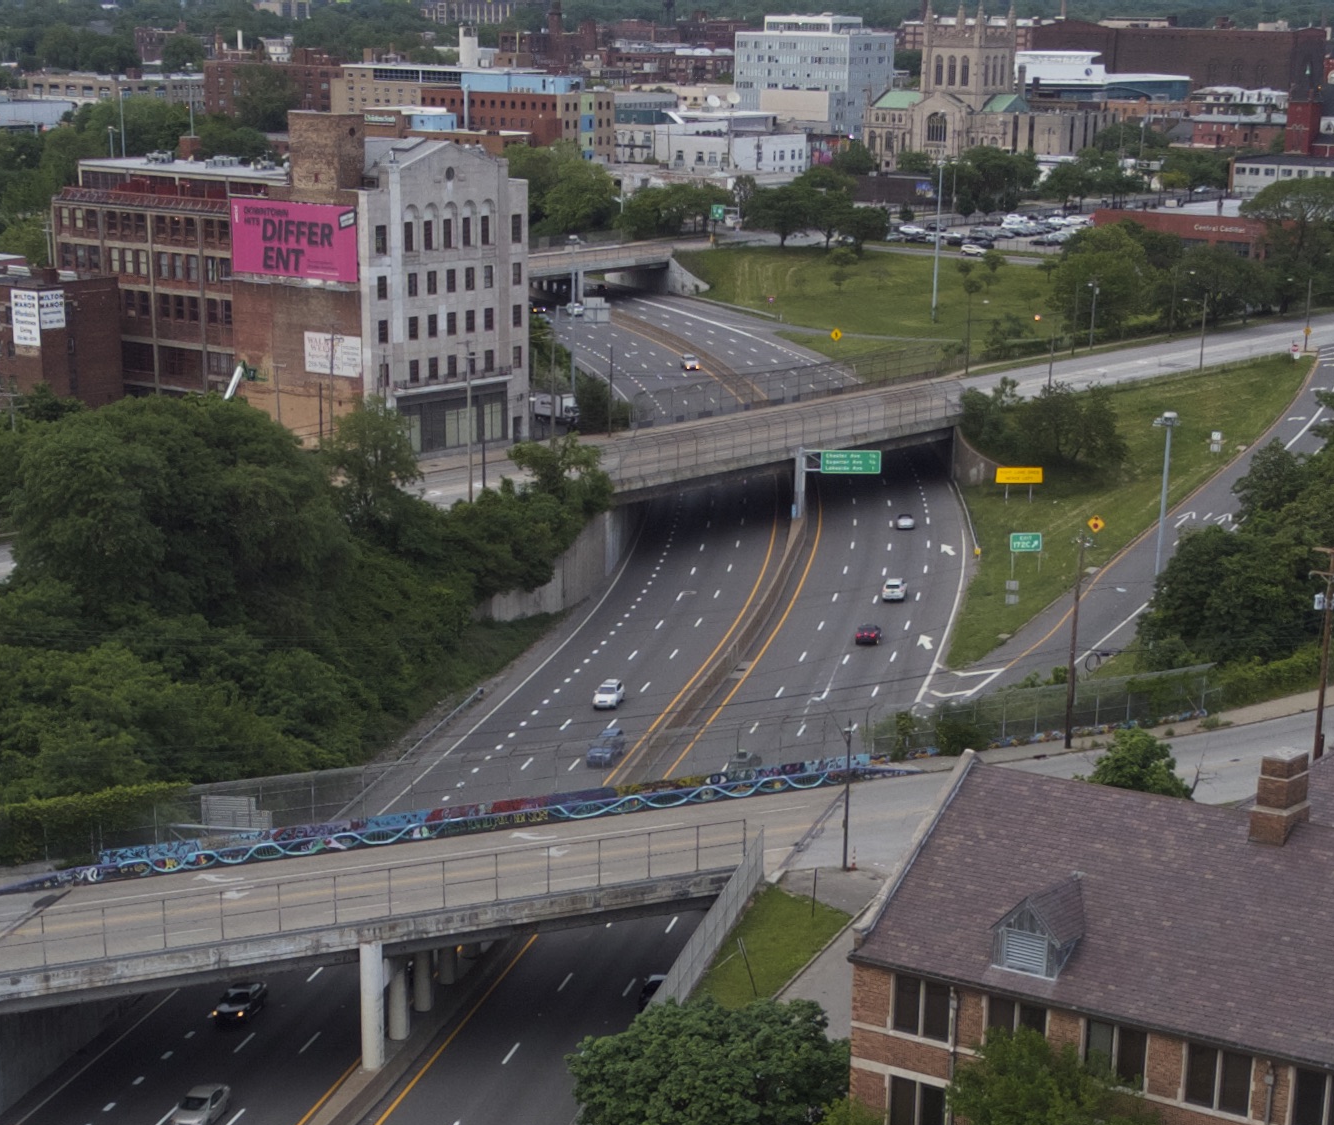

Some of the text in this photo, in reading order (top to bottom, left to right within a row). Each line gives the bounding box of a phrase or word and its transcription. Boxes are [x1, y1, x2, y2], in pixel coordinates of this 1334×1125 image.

[244, 206, 288, 216] DOWNTOWN
[244, 217, 260, 225] HITS
[262, 219, 333, 247] DIFFER
[263, 246, 304, 272] ENT
[1013, 541, 1032, 549] 172C
